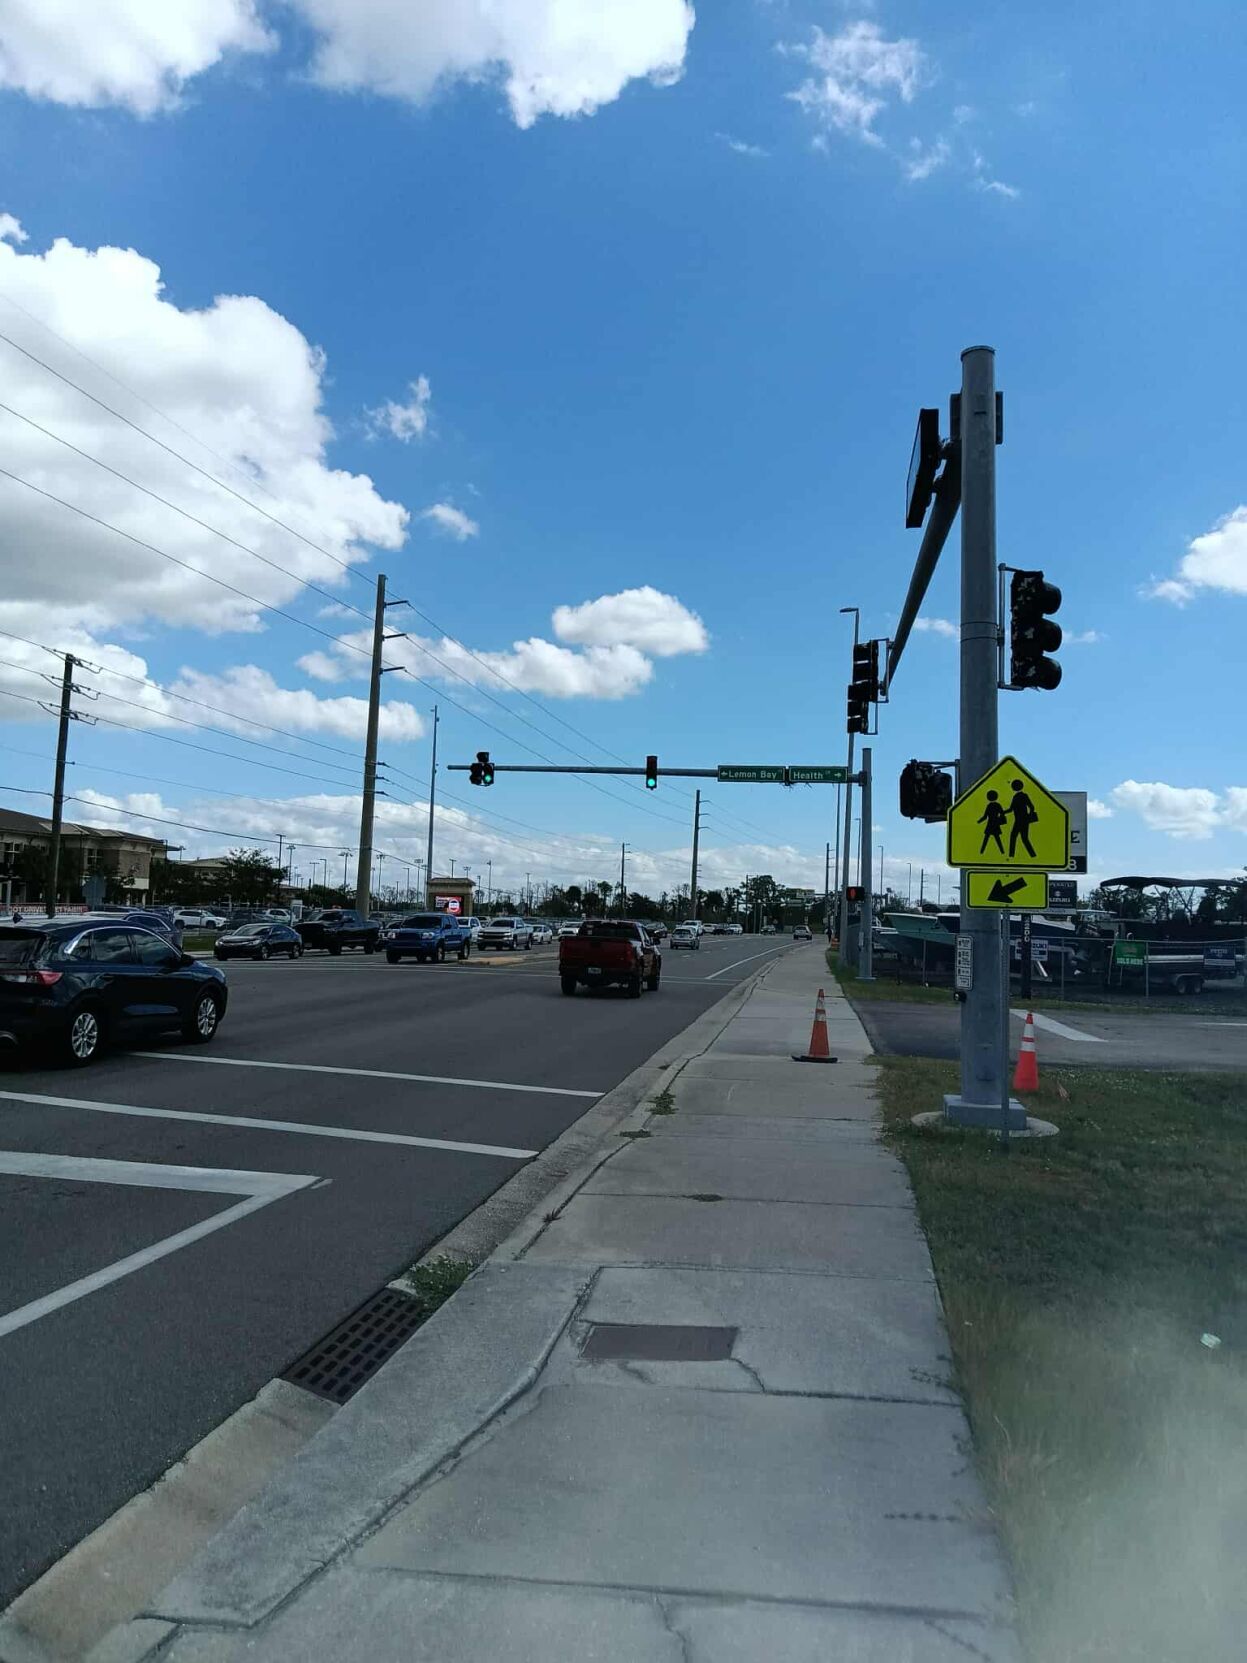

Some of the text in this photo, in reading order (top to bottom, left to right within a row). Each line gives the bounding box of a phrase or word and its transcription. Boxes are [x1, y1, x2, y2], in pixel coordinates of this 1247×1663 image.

[728, 769, 757, 779] Lemon
[760, 770, 777, 780] Bay
[793, 771, 824, 780] Health
